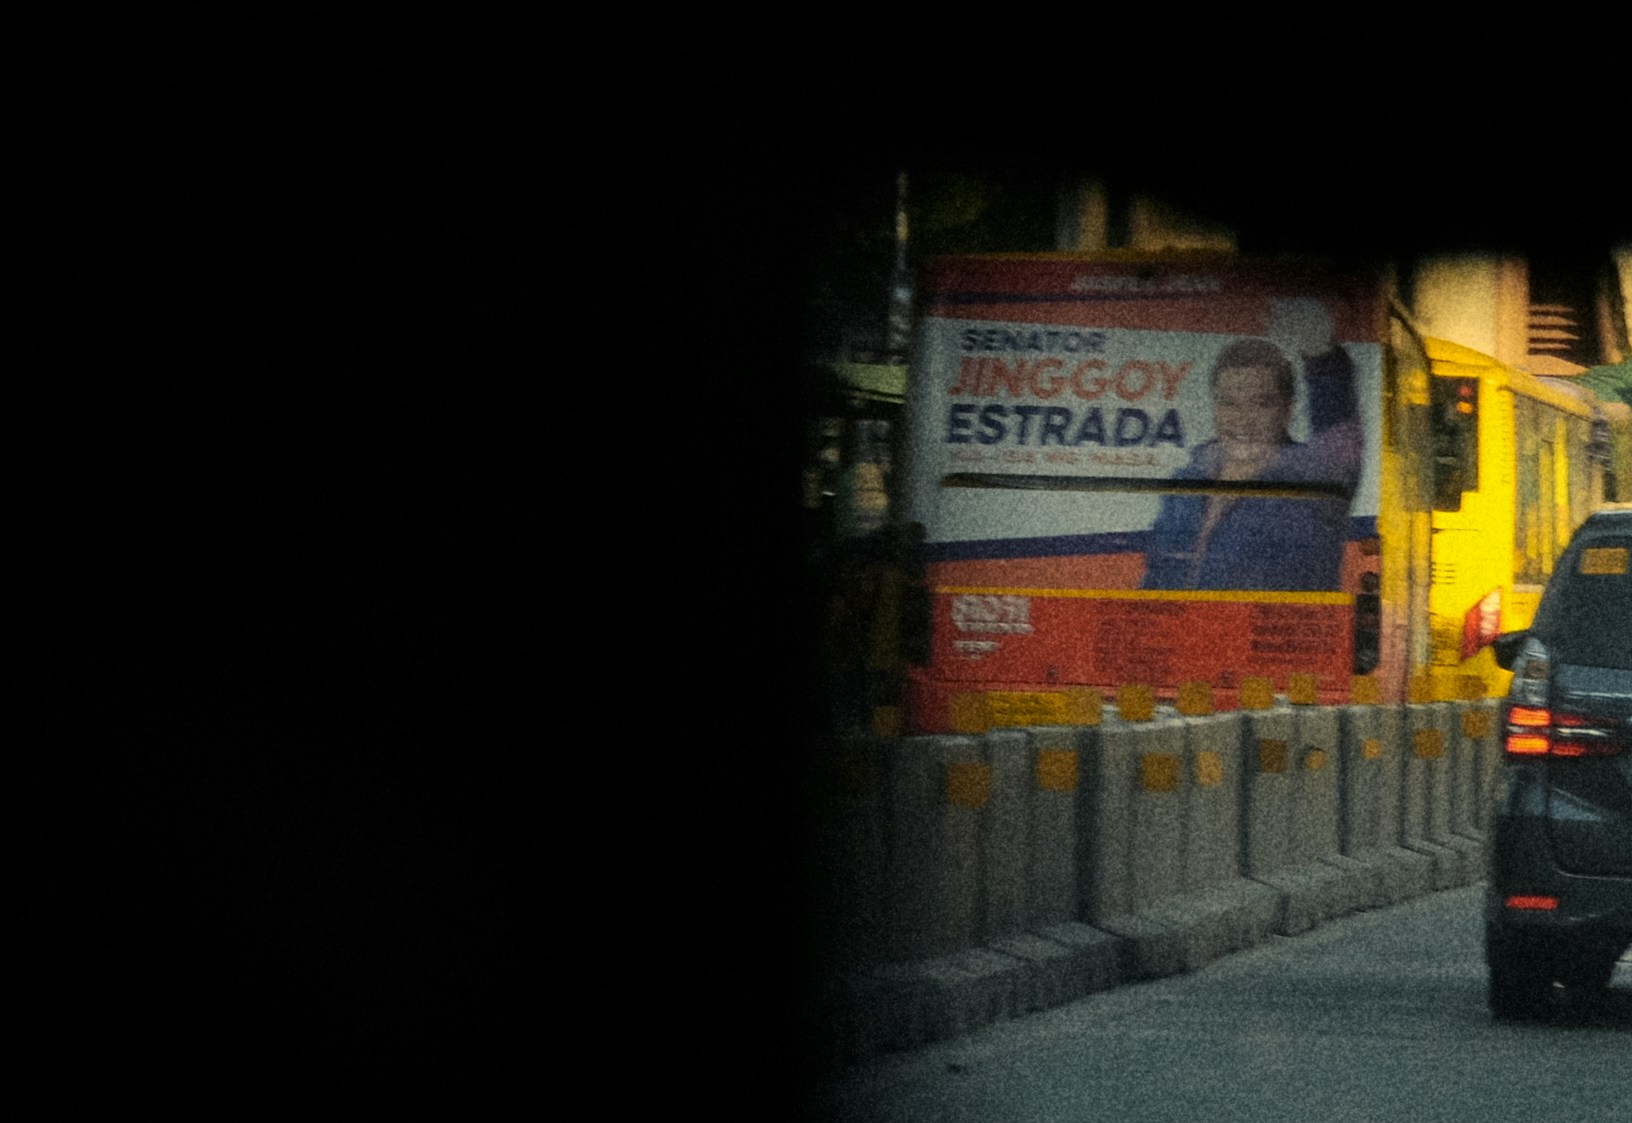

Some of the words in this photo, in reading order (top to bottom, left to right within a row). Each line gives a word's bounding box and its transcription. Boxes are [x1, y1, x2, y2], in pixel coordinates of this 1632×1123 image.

[963, 329, 1107, 353] SENATOR
[948, 355, 1194, 401] JINGGOY
[947, 403, 1186, 448] ESTRADA
